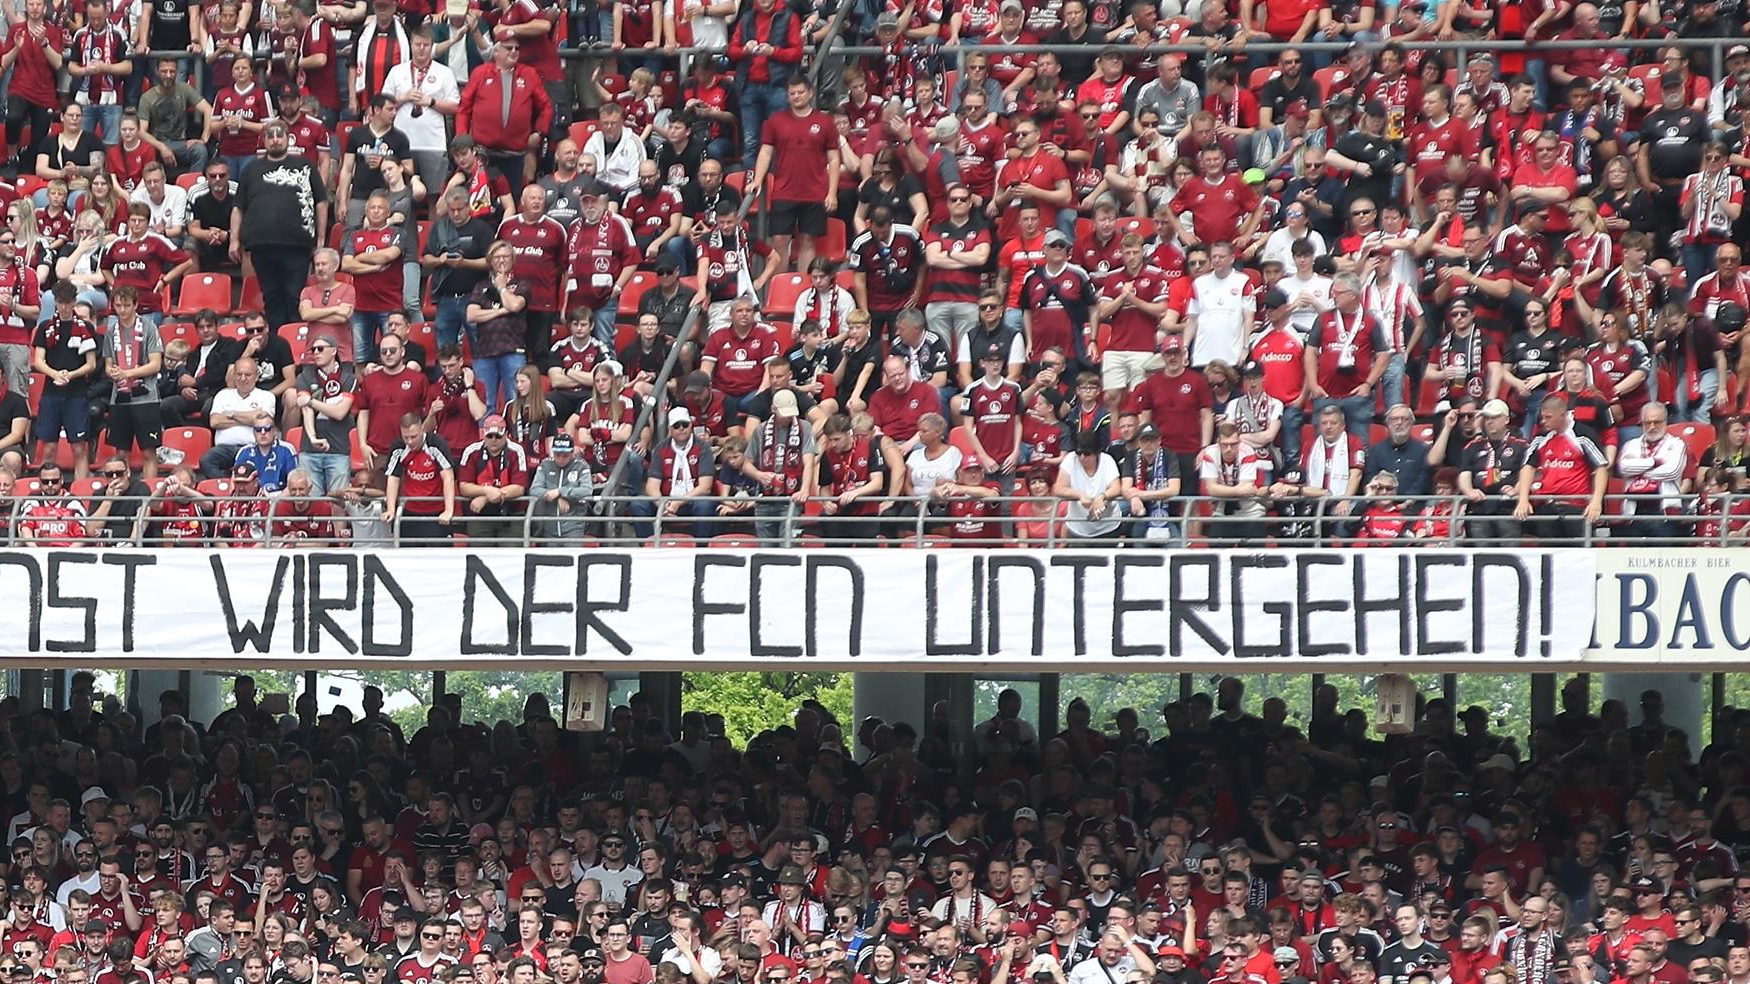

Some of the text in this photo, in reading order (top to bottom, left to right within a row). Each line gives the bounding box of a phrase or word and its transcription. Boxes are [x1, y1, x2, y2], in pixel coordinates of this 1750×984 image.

[1627, 556, 1732, 568] KULMBACHER BIER
[210, 553, 414, 657] WIRD
[460, 554, 633, 657] DER
[692, 554, 865, 657] FCN
[926, 553, 1552, 658] UNTERGEHEN!
